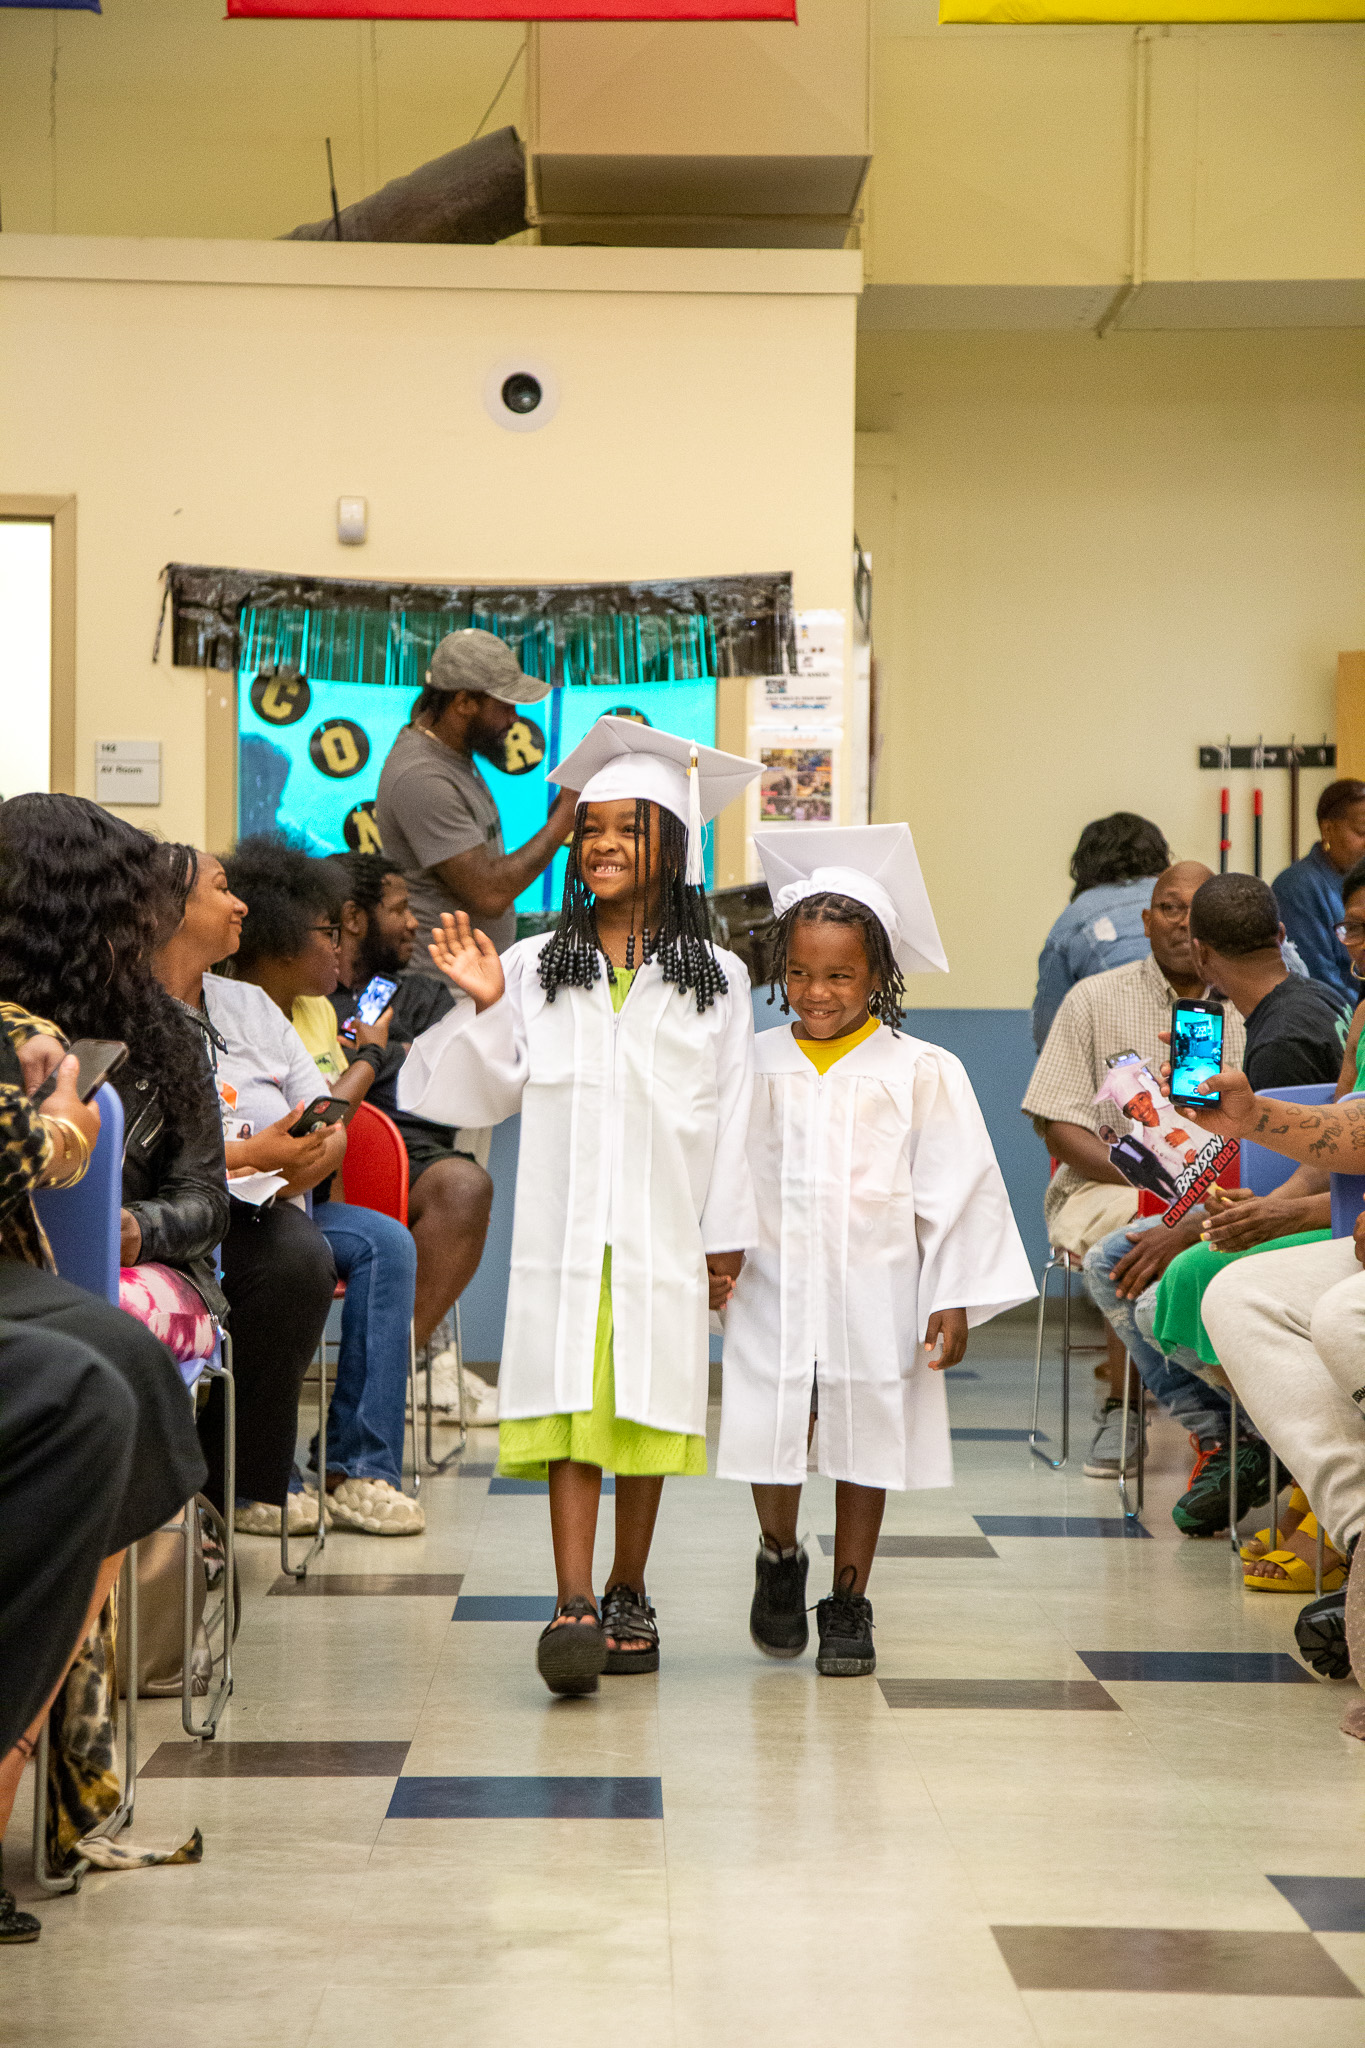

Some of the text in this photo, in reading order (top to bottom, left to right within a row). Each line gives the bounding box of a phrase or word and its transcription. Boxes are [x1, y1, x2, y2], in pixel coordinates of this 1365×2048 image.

[1163, 1139, 1240, 1227] CONGRATS 2023
[1174, 1134, 1224, 1198] BRYSON
